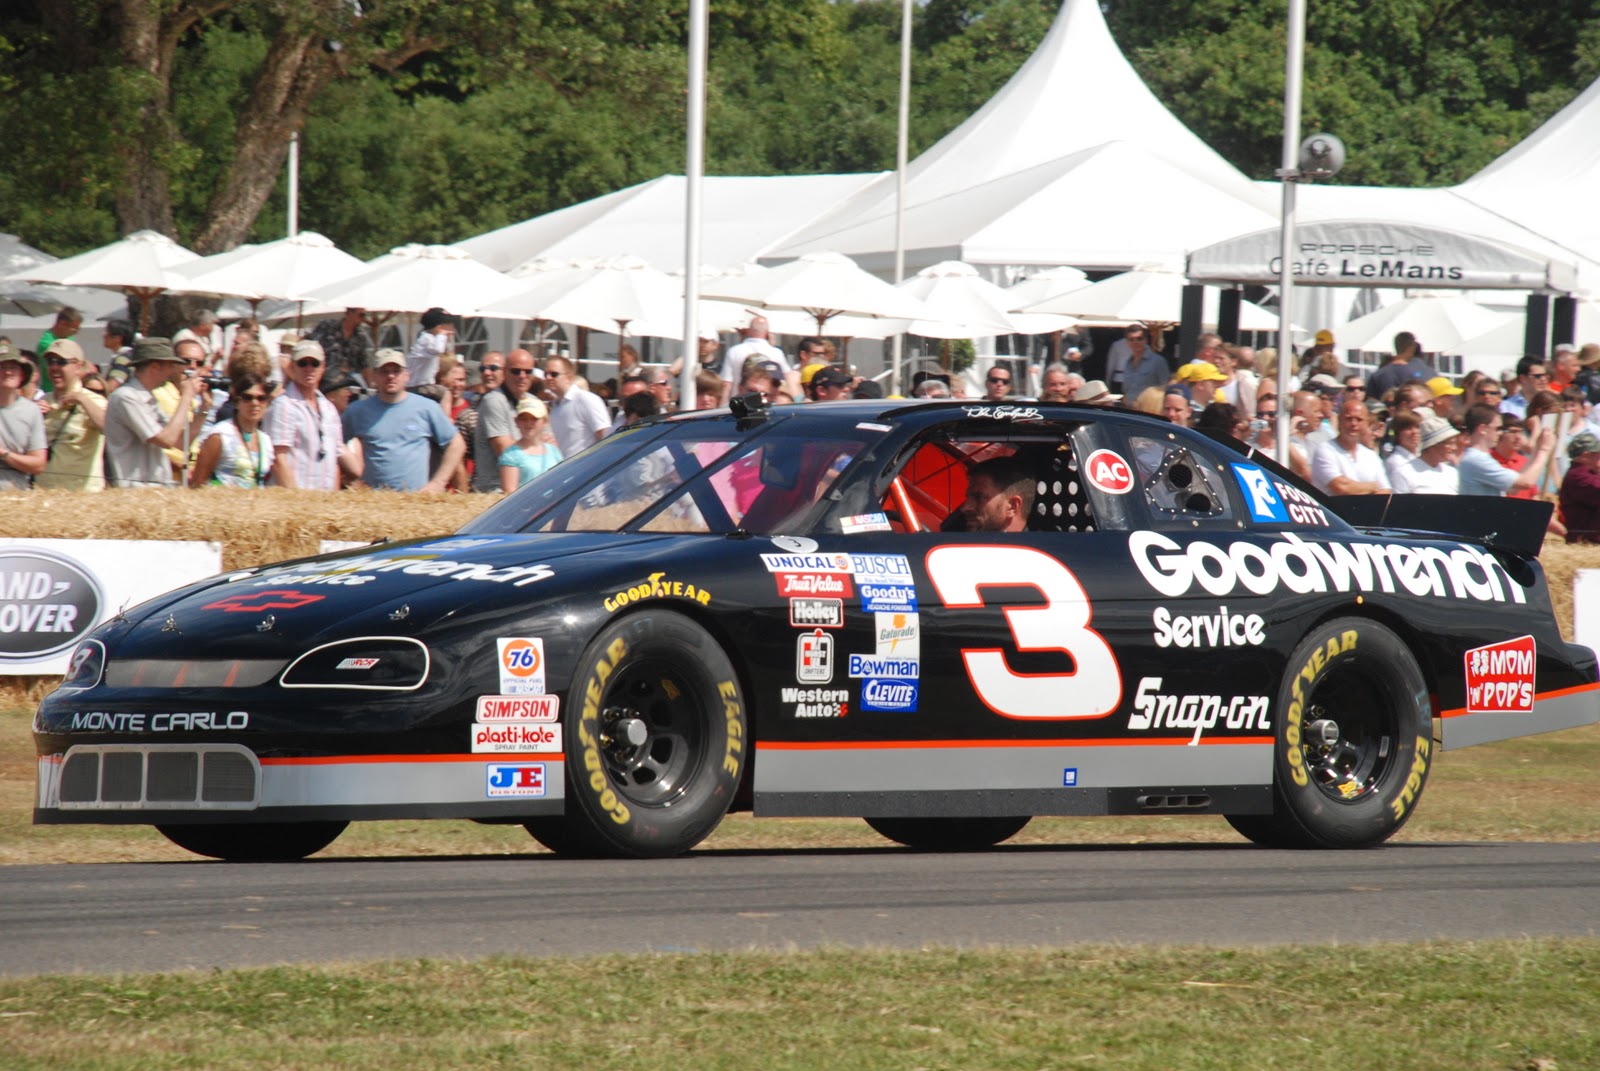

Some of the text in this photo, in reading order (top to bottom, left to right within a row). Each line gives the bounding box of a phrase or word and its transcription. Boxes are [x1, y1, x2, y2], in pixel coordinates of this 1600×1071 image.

[1300, 243, 1435, 256] PORSCHE
[1340, 257, 1463, 281] LeMans
[1096, 461, 1129, 483] AC
[1288, 502, 1330, 527] CITY
[767, 556, 836, 569] UNOCAL
[851, 556, 911, 575] BUSCH
[1128, 530, 1527, 604] Goodwrench
[603, 572, 712, 613] GOODYEAR
[861, 585, 915, 600] Goody's
[794, 601, 838, 624] Holley
[880, 625, 915, 641] Gatorade
[925, 543, 1123, 721] 3
[1153, 605, 1266, 648] Service
[510, 648, 534, 667] 76
[1490, 649, 1533, 676] MOM
[781, 688, 849, 703] Western
[865, 679, 915, 702] CLEVITE
[1483, 680, 1533, 708] POP'S
[483, 700, 551, 718] SIMPSON
[795, 703, 832, 718] Auto
[1127, 677, 1271, 746] Snap-on
[1286, 629, 1358, 787] GOODYEAR
[71, 711, 249, 731] MONTE CARLO
[578, 637, 631, 825] GOODYEAR
[718, 680, 743, 778] EAGLE
[477, 726, 555, 744] plasti-kote
[490, 767, 542, 788] JE
[1391, 735, 1429, 820] EAGLE
